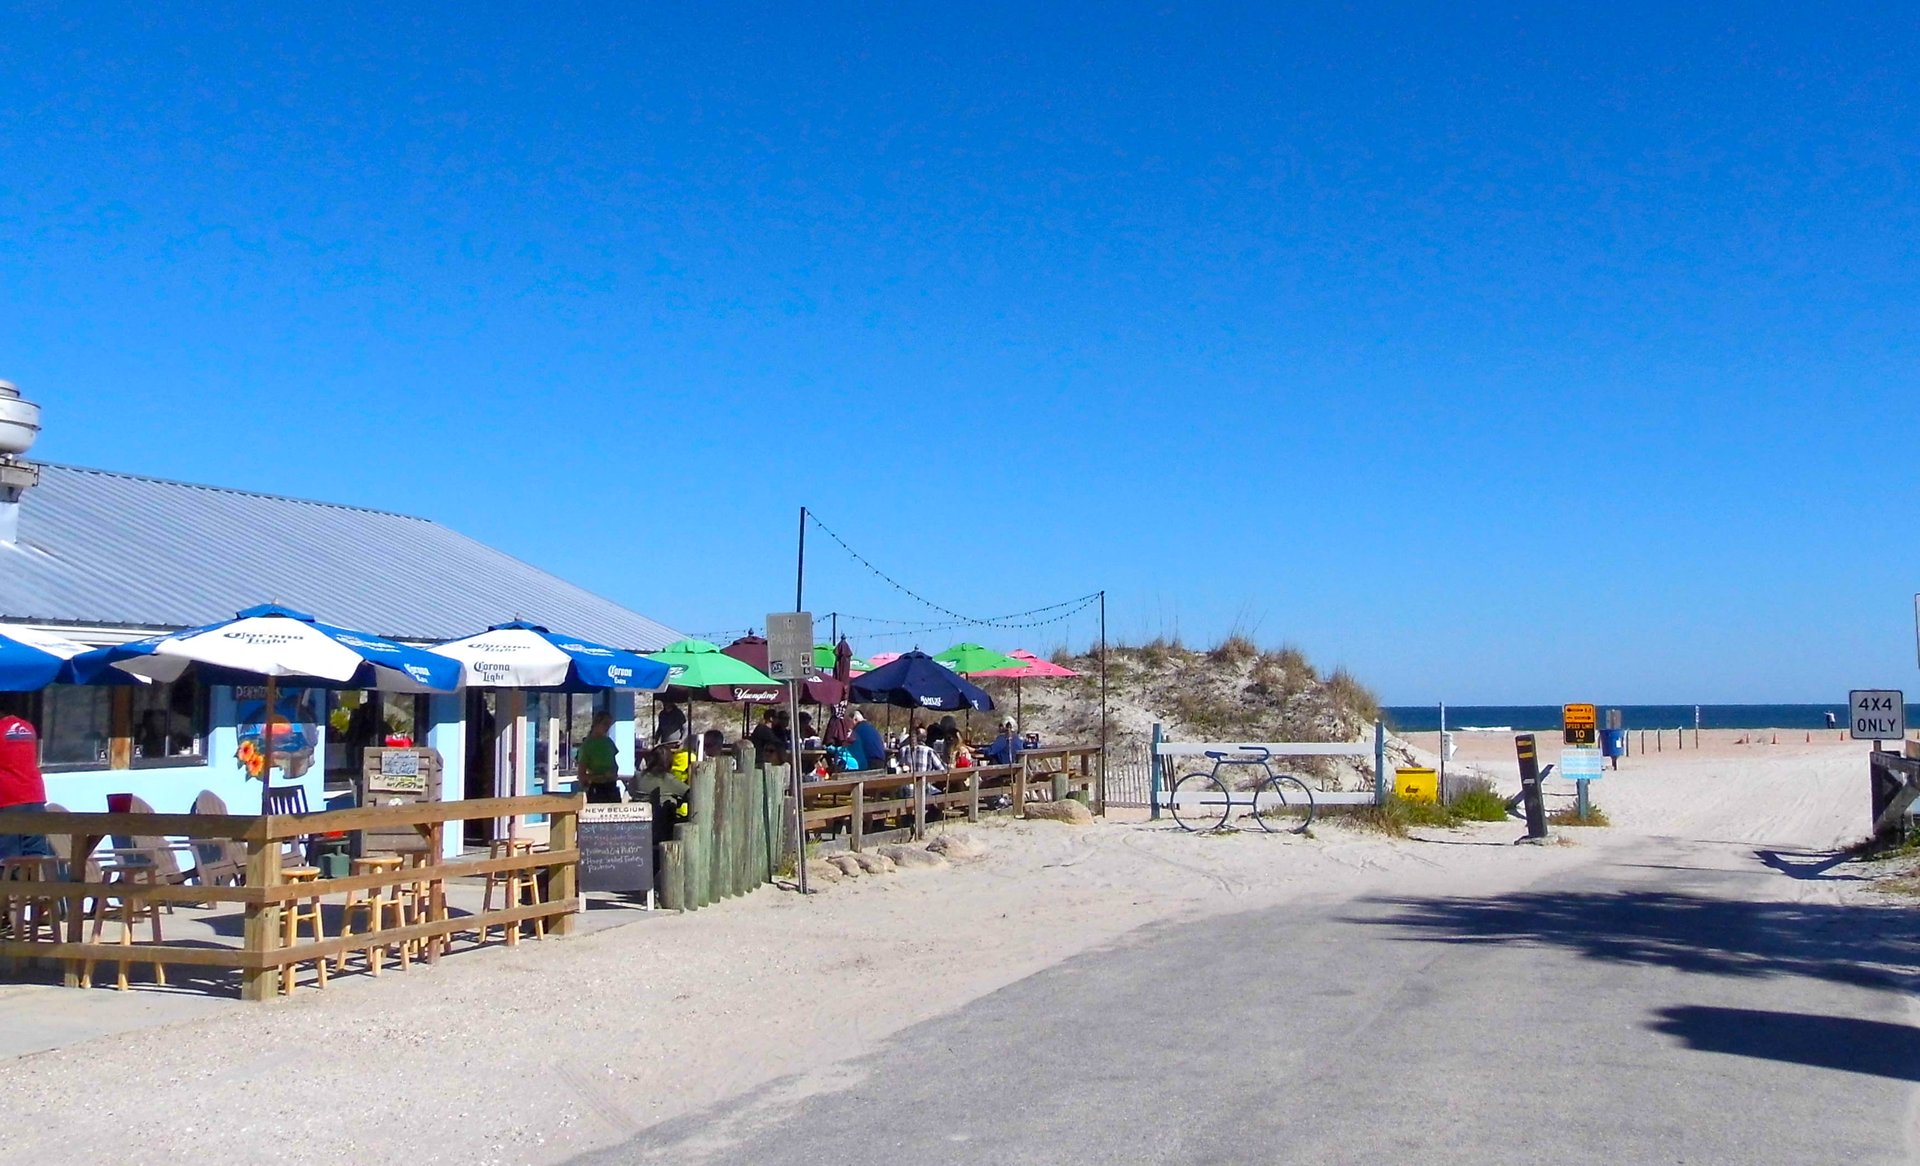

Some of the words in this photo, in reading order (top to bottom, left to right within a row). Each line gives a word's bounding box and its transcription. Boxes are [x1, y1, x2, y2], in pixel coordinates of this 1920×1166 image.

[473, 661, 510, 672] Corona
[607, 664, 633, 677] Corona
[482, 672, 505, 683] Light
[733, 687, 780, 701] Yuengling
[1858, 697, 1892, 711] 4X4
[1857, 718, 1896, 732] ONLY
[1575, 730, 1585, 738] 10
